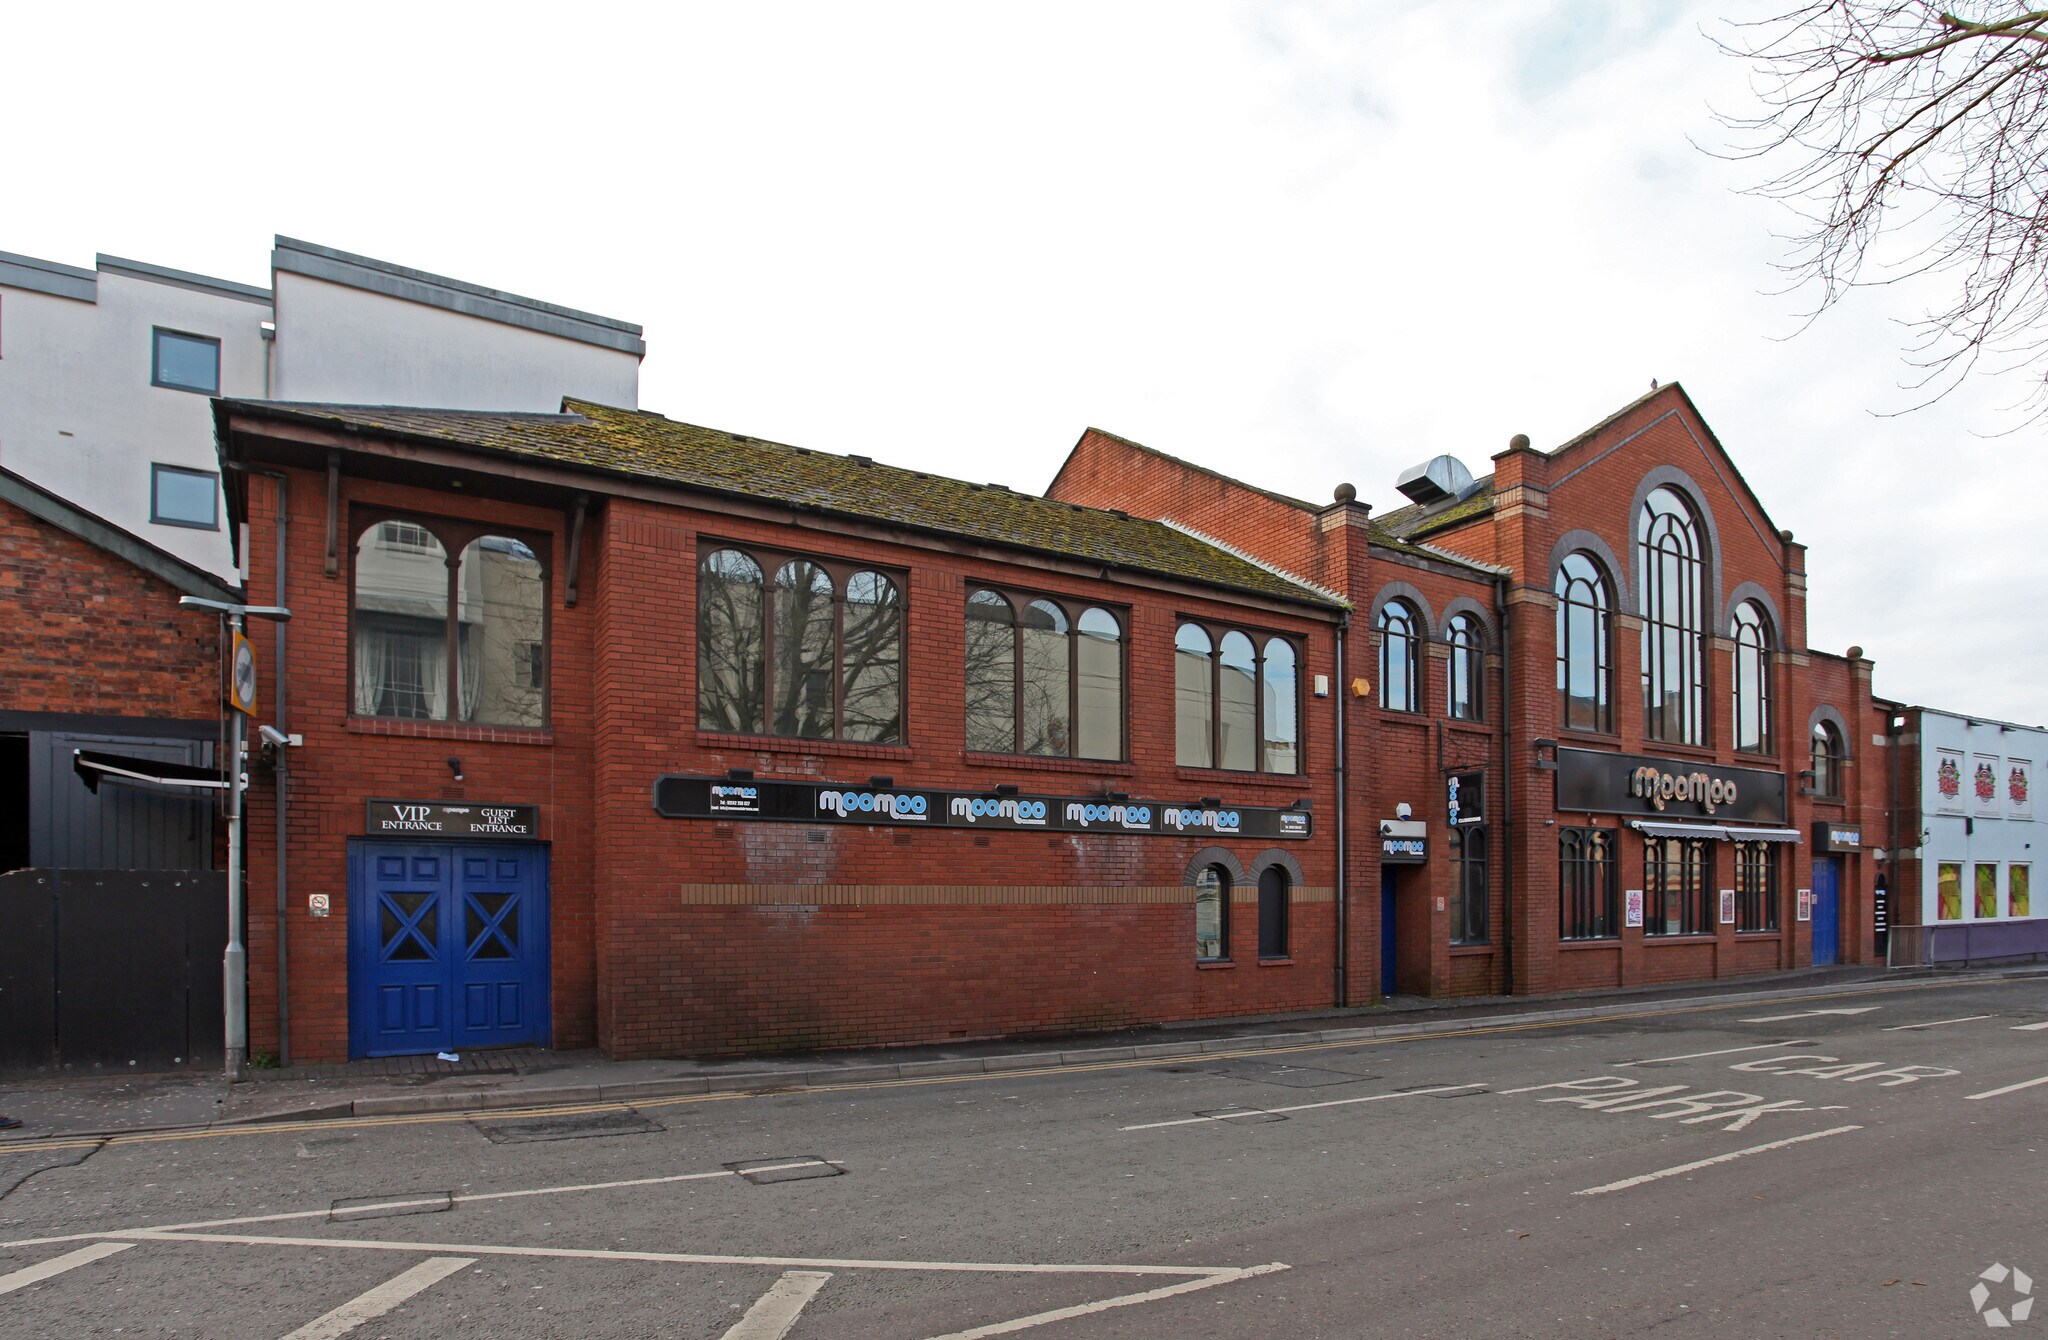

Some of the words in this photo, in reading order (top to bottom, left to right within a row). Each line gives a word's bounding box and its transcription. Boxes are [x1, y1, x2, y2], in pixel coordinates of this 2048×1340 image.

[393, 805, 431, 821] VIP
[480, 808, 517, 818] GUEST
[487, 815, 511, 825] LIST
[382, 821, 442, 831] ENTRANCE
[470, 823, 527, 834] ENTRANCE
[1729, 1055, 1961, 1086] CAR
[1496, 1076, 1849, 1131] PARK
